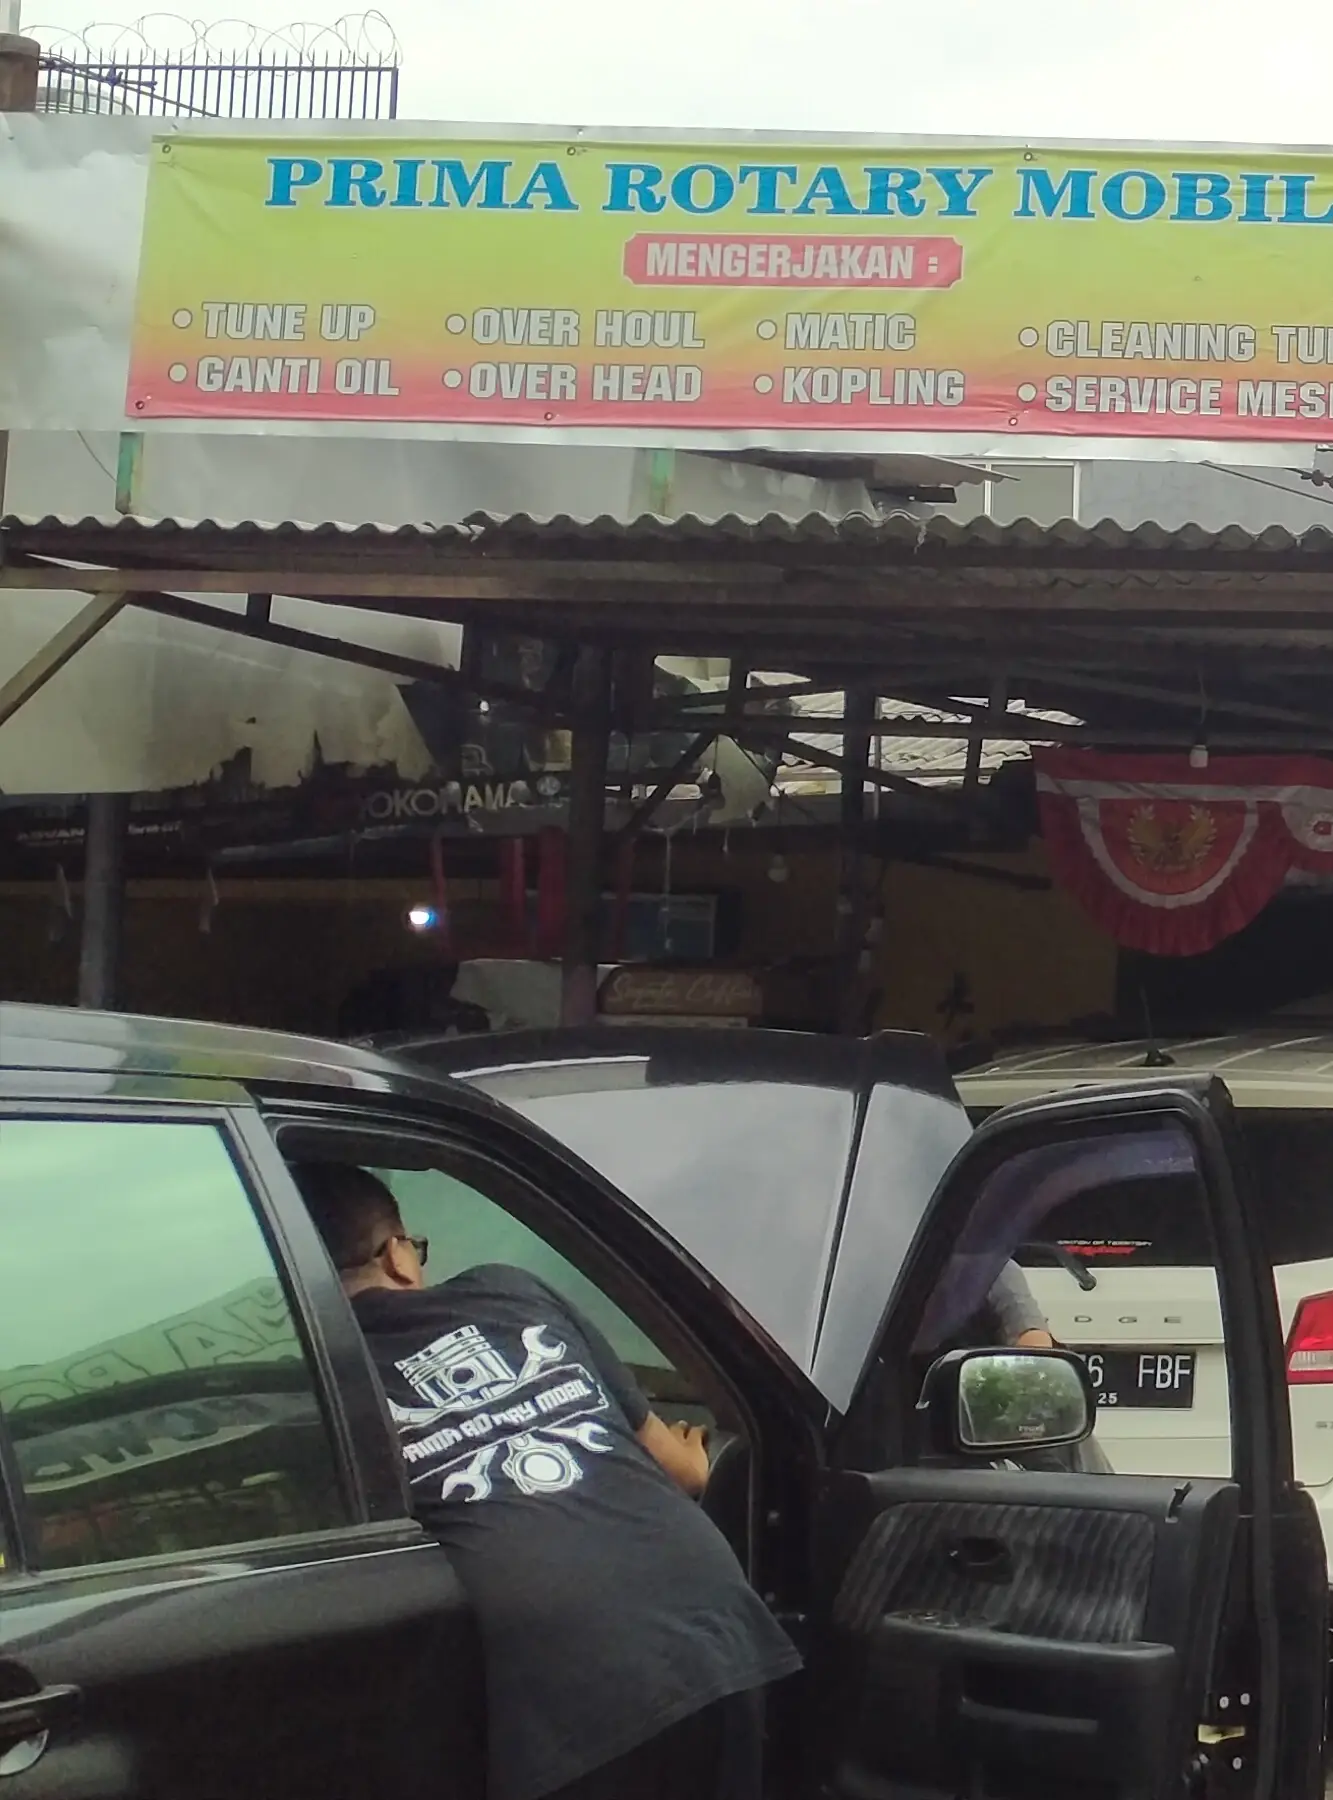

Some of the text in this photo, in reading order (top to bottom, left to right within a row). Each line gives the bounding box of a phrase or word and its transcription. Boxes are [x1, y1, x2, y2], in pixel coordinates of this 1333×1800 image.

[265, 157, 580, 212] PRIMA
[601, 162, 994, 218] ROTARY
[646, 242, 913, 279] MENGERJAKAN
[202, 302, 376, 341] TUNE UP
[471, 308, 706, 349] OVER HOUL
[784, 312, 916, 351] MATIC
[1046, 320, 1257, 362] CLEANING
[196, 356, 400, 397] GANTI OIL
[468, 361, 703, 403] OVER HEAD
[781, 366, 965, 406] KOPLING
[1044, 374, 1227, 417] SERVICE
[1138, 1354, 1192, 1389] FBF
[534, 1379, 592, 1413] MOBIL
